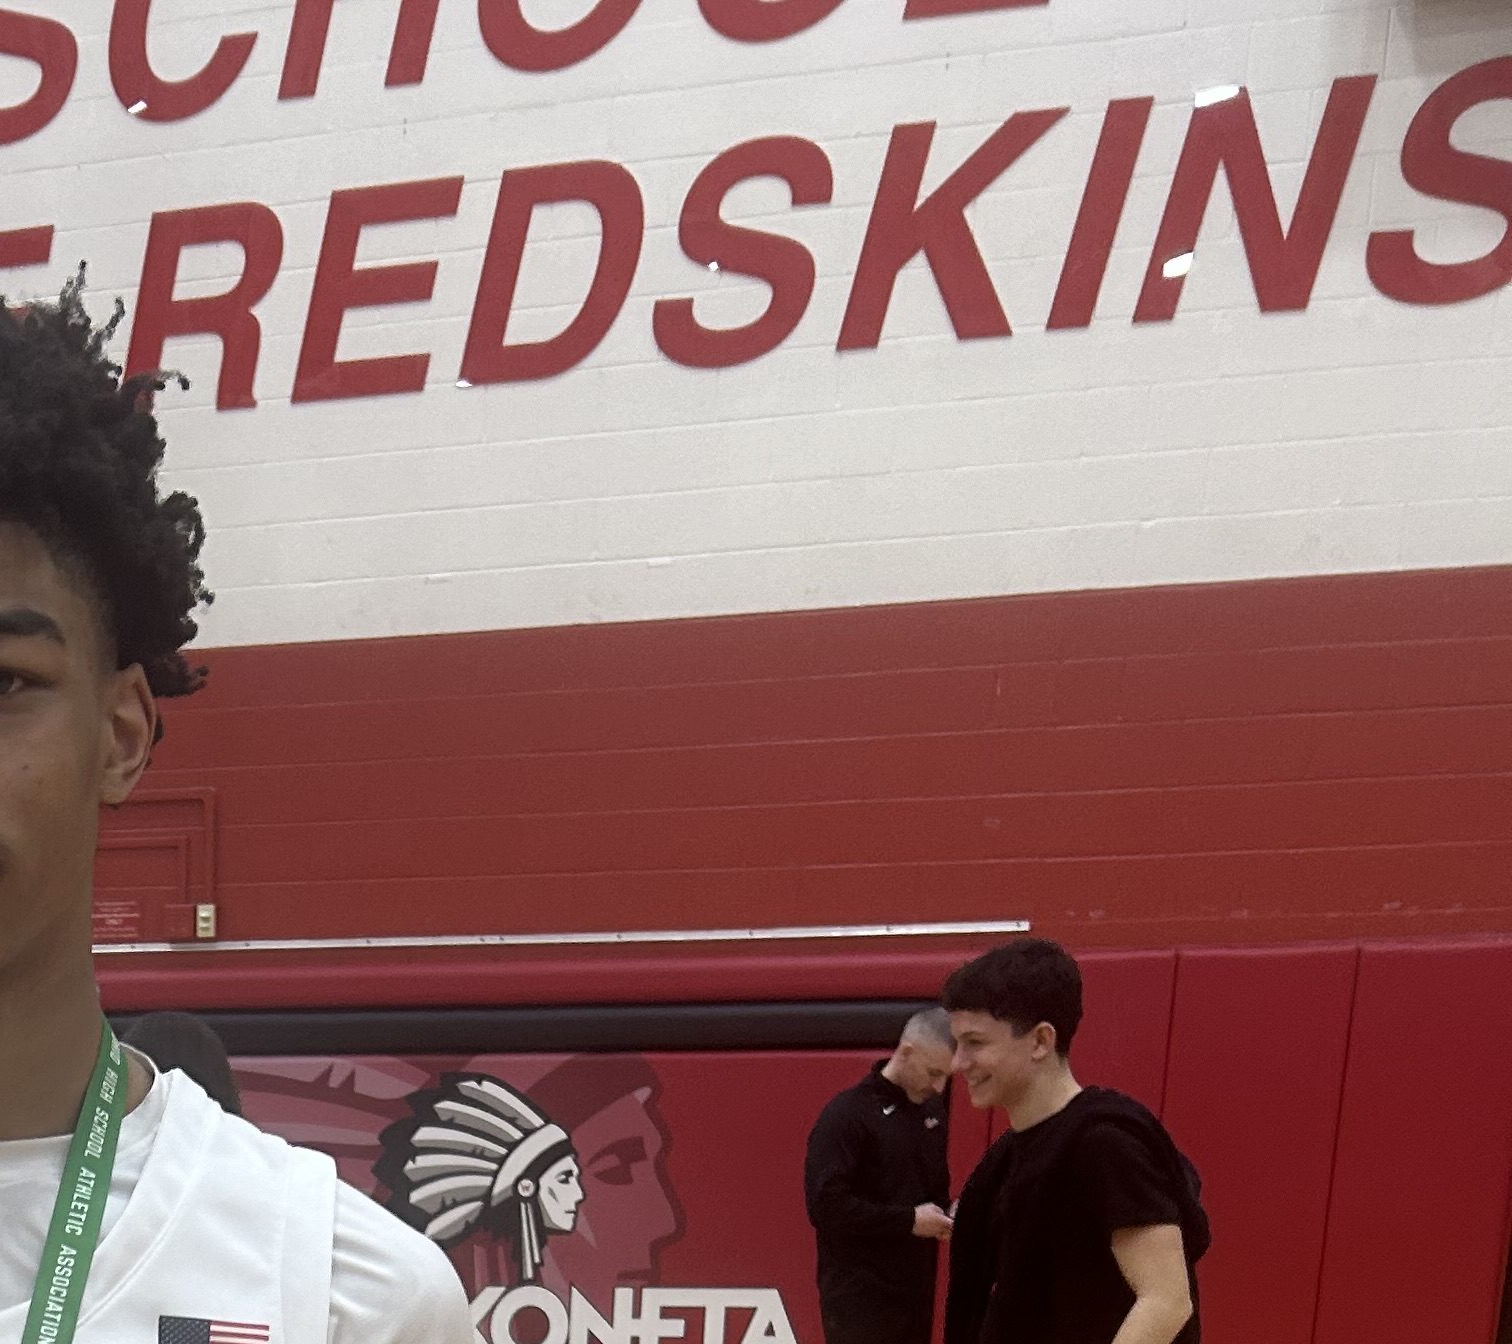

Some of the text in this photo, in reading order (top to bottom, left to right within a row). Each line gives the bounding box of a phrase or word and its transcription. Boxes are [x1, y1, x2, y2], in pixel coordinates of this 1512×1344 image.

[120, 55, 1512, 413] REDSKINS
[83, 1106, 110, 1160] SCHOOL
[64, 1166, 97, 1237] ATHLETIC
